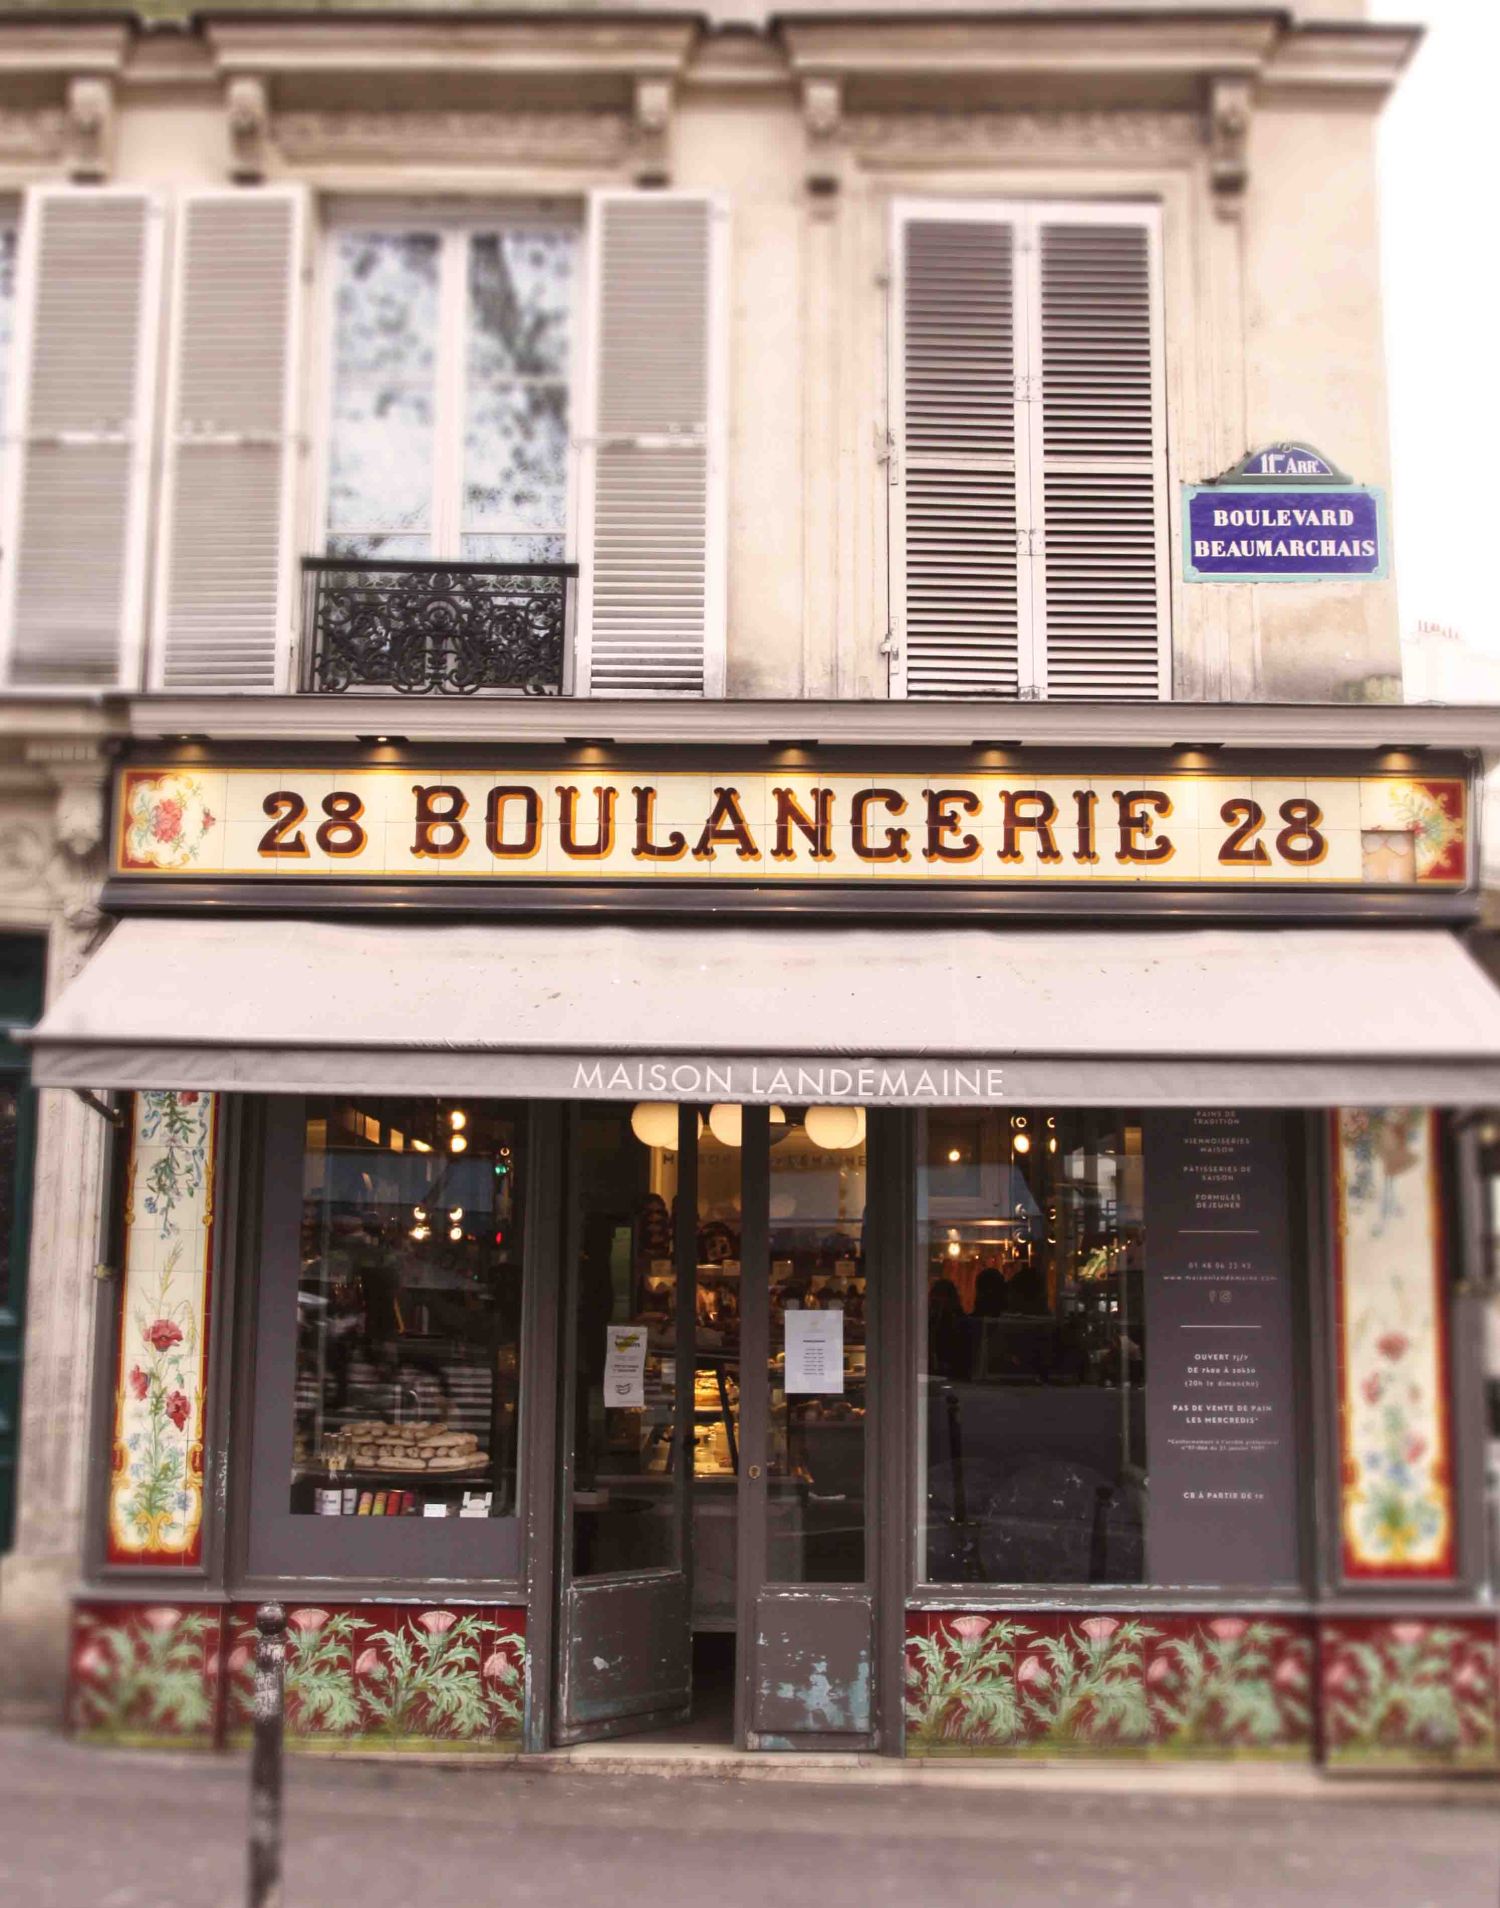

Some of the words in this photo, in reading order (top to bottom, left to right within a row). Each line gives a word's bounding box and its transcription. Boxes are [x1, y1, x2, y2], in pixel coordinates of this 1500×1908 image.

[1213, 509, 1354, 527] BOULEVARD
[1194, 540, 1375, 557] BEAUMARCHAIS
[257, 790, 368, 859] 28
[410, 785, 1176, 865] BOULANGERIE
[1218, 797, 1330, 867] 28
[572, 1062, 734, 1093] MAISON
[752, 1067, 1004, 1096] LANDEMAINE
